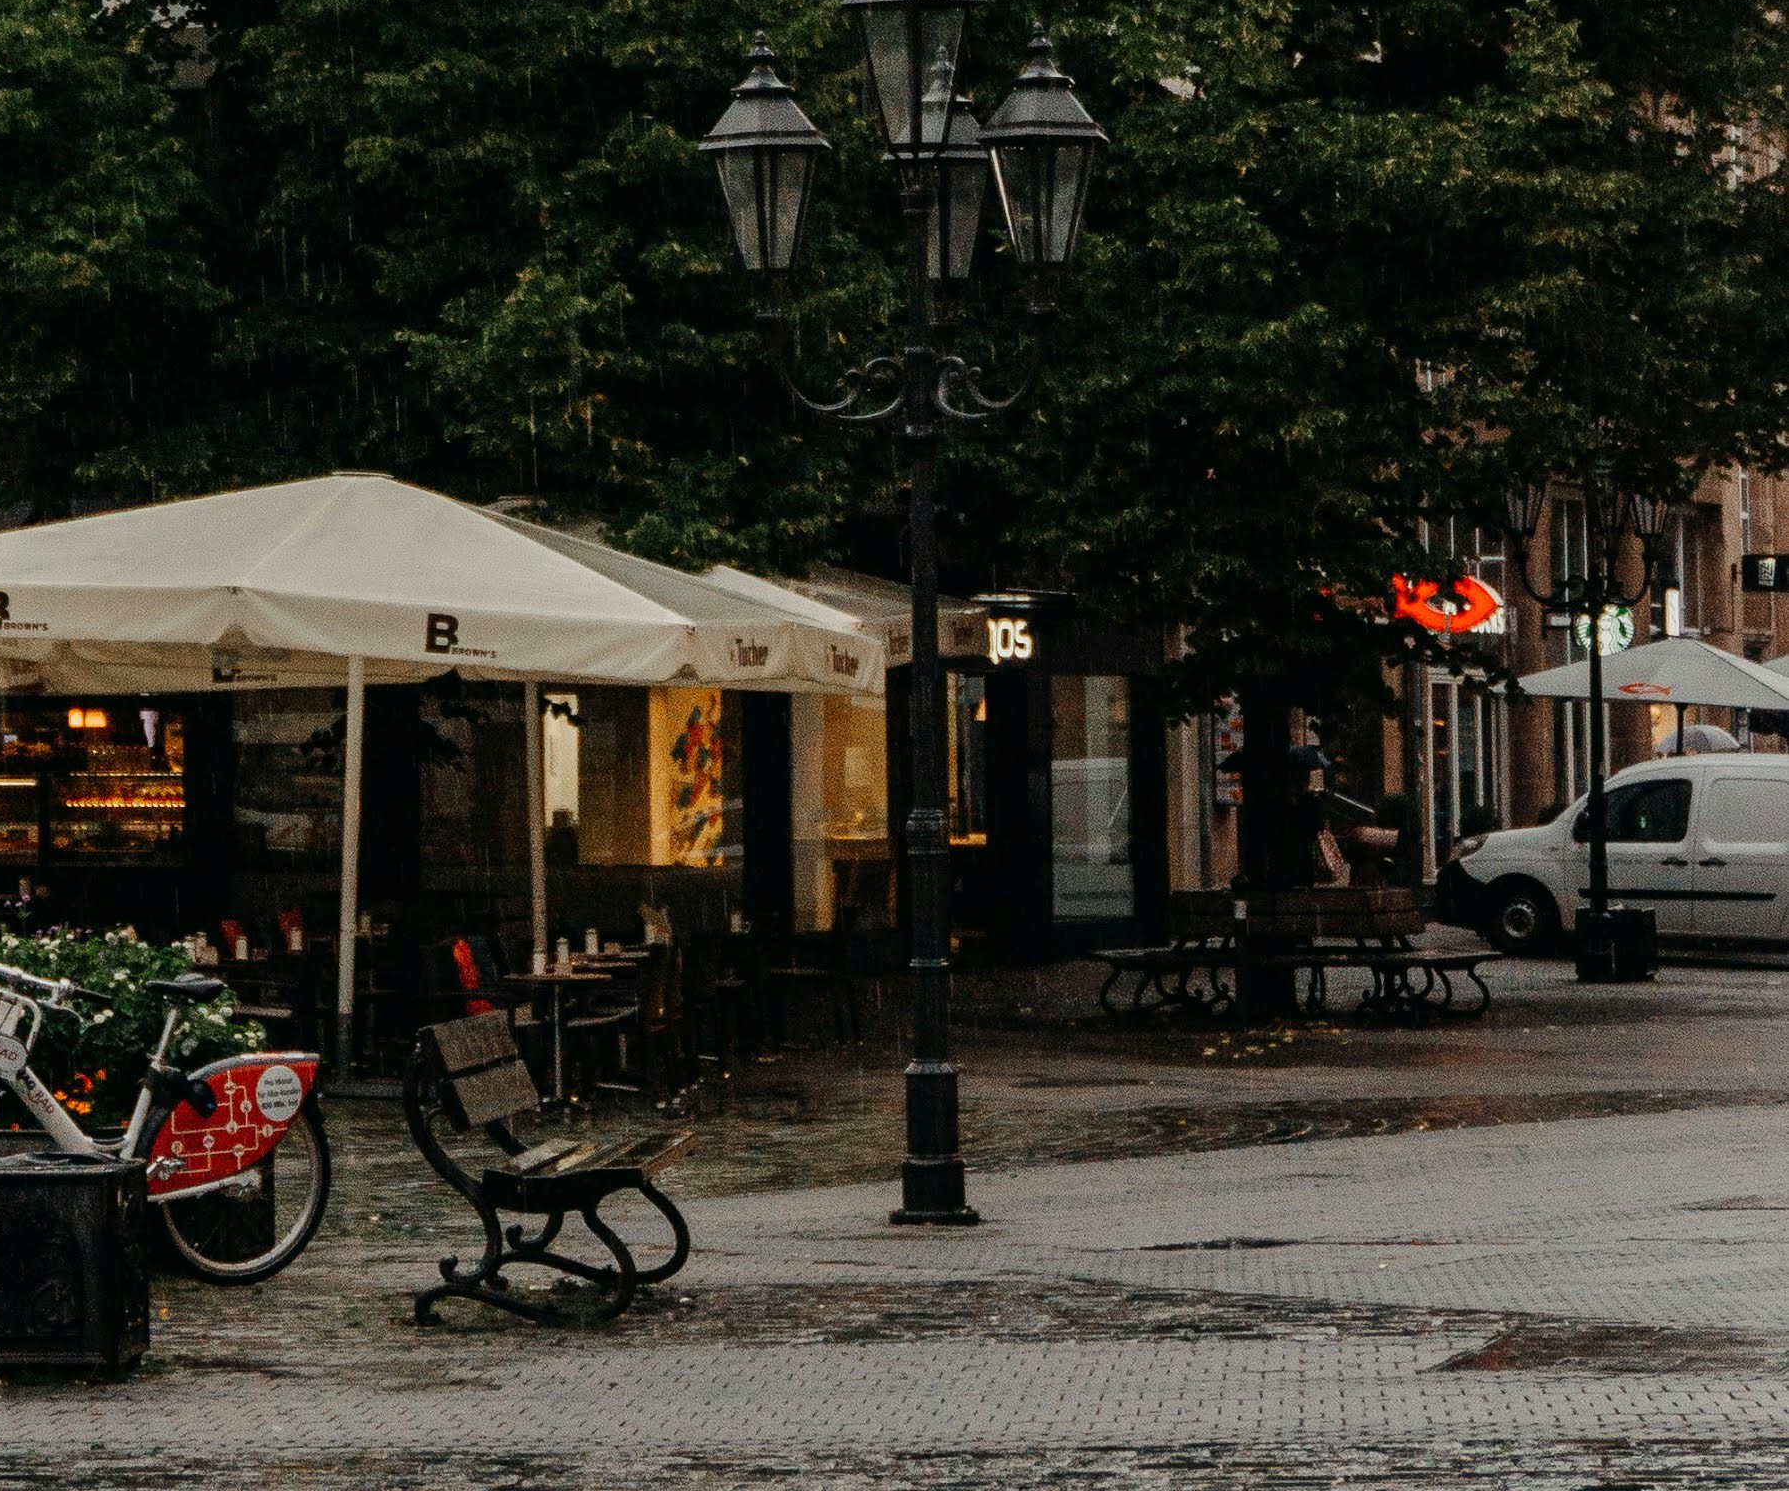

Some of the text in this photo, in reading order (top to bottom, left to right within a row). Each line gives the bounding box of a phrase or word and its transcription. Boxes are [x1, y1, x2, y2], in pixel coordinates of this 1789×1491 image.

[4, 622, 49, 631] BROWN'S
[425, 613, 459, 654] B
[451, 647, 498, 659] BROWN'S
